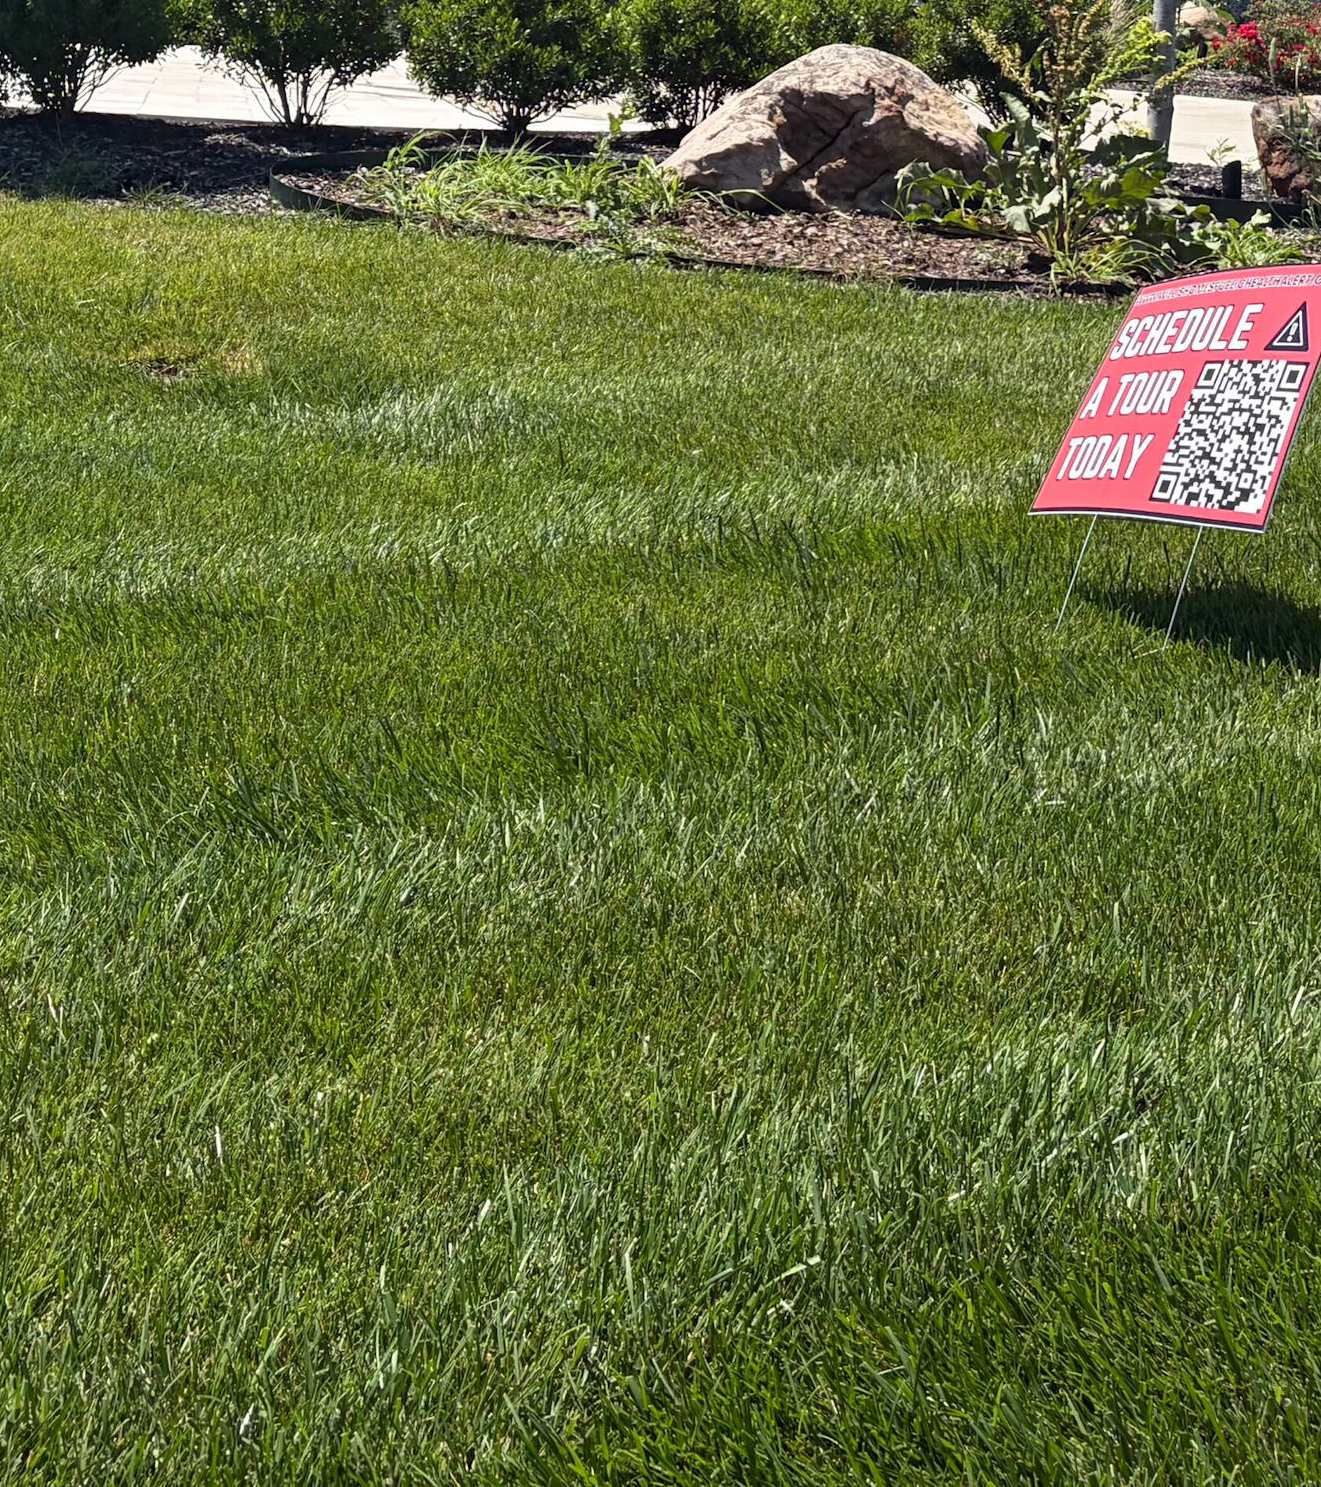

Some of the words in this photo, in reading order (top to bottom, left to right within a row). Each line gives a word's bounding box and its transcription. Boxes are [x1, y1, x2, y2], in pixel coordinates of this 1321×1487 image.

[1109, 302, 1265, 360] SCHEDULE
[1079, 377, 1109, 420] A
[1108, 369, 1184, 417] TOUR
[1056, 433, 1155, 481] TODAY
